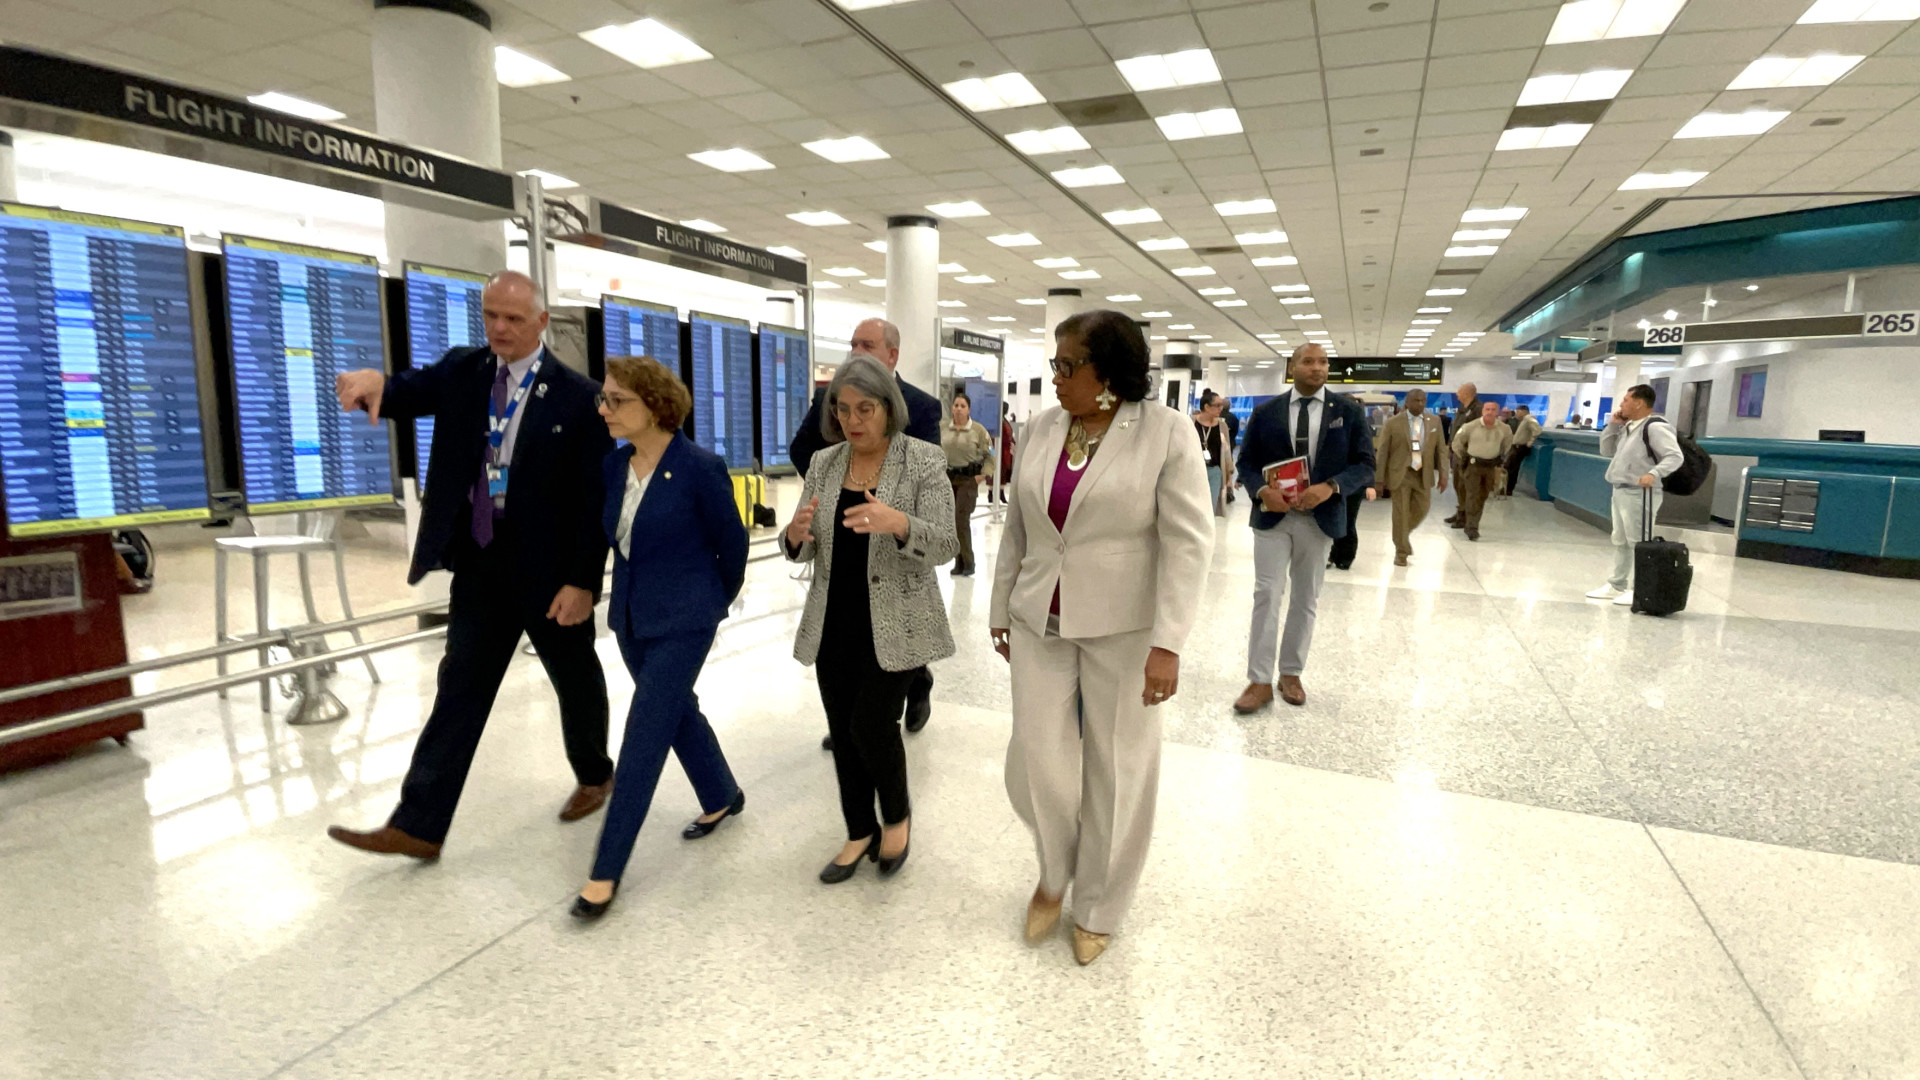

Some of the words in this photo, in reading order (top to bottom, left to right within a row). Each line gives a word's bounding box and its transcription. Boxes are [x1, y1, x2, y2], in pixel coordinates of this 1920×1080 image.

[124, 85, 246, 135] FLIGHT
[254, 117, 435, 183] INFORMATION
[656, 225, 701, 251] FLIGHT
[704, 239, 775, 272] INFORMATION
[1646, 326, 1683, 345] 268
[1866, 313, 1916, 334] 265
